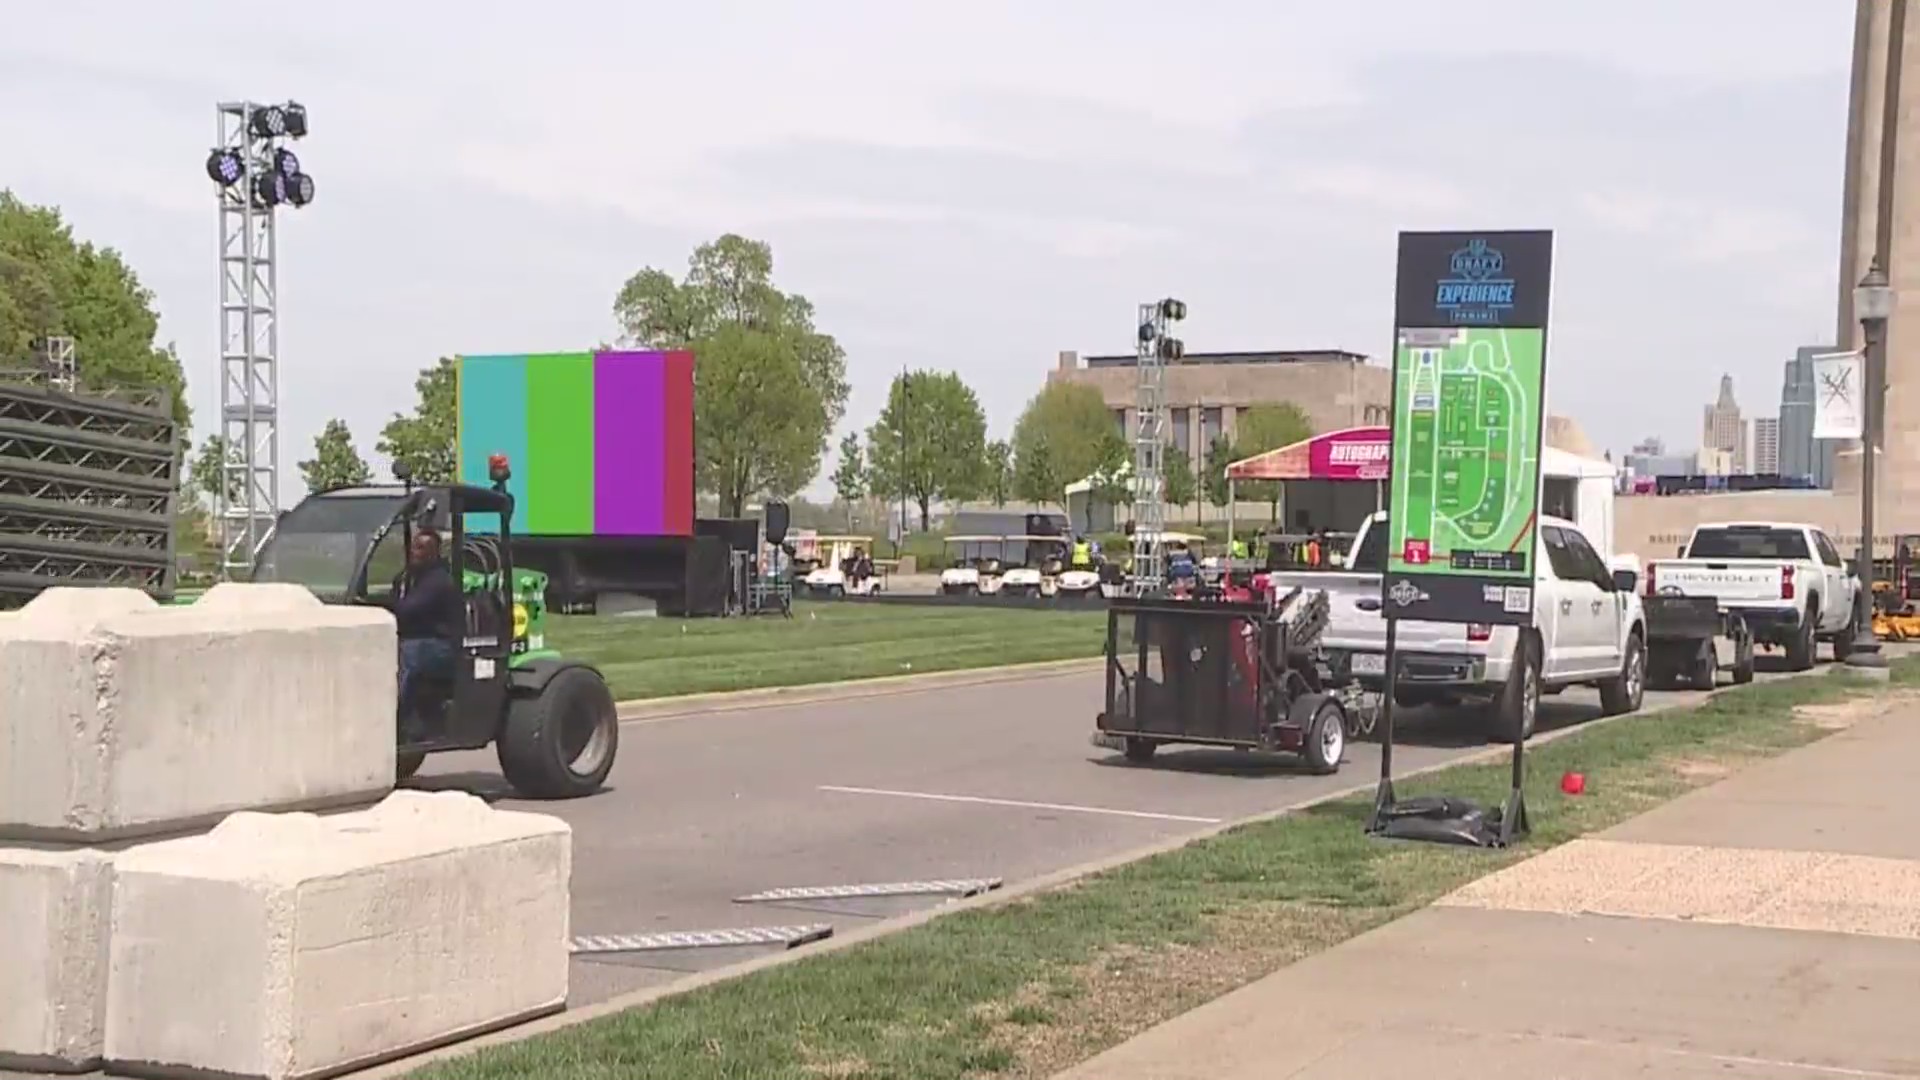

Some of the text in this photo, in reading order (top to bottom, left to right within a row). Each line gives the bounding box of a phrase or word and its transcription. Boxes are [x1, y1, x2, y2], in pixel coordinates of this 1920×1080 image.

[1438, 285, 1514, 303] EXPERIENCE
[1412, 550, 1421, 562] 1
[1663, 573, 1773, 584] CHEVROLET
